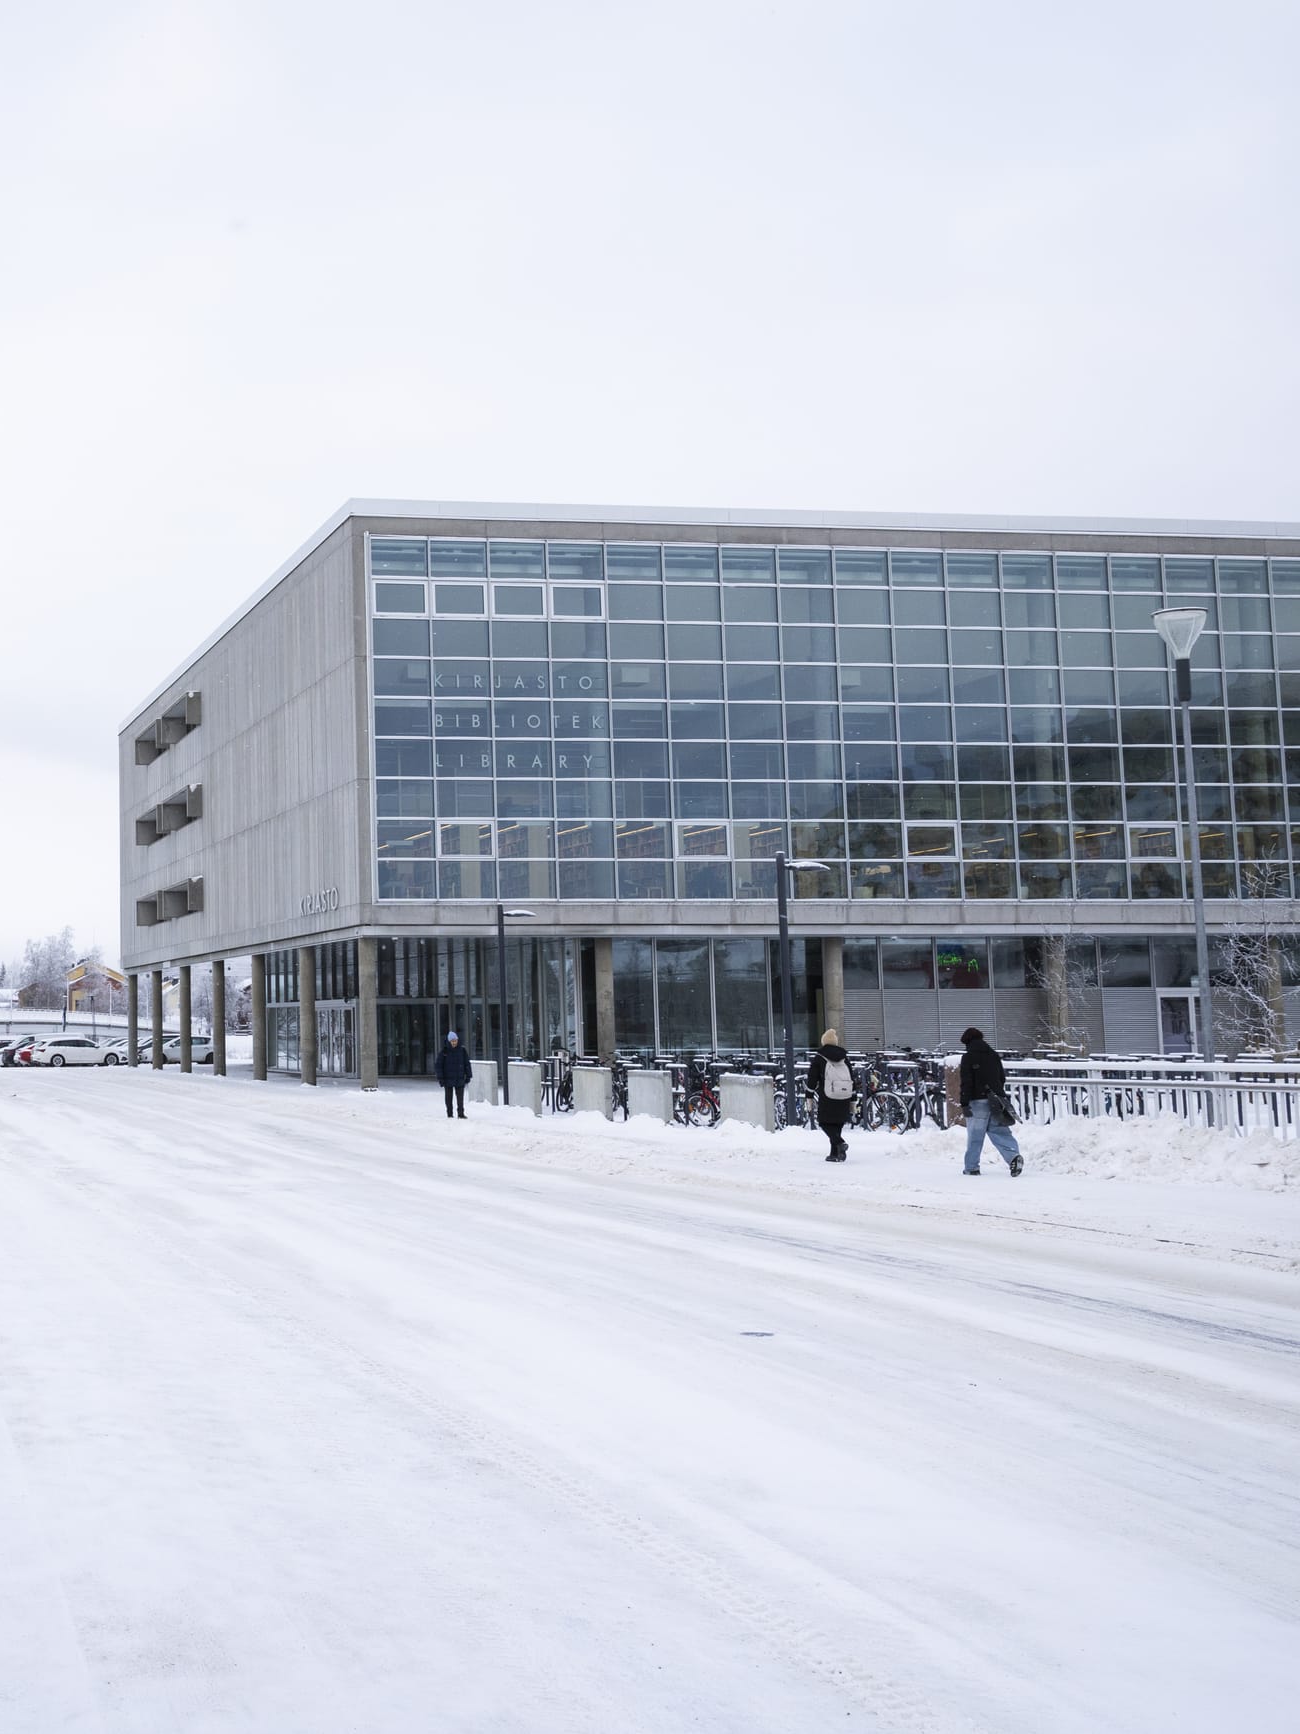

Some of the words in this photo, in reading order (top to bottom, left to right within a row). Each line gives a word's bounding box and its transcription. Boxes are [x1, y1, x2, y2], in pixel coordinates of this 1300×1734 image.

[434, 674, 593, 690] KIRJASTO
[435, 714, 603, 729] BIBLIOTEK
[436, 754, 593, 769] LIBRARY
[300, 887, 340, 917] KIRJASTO
